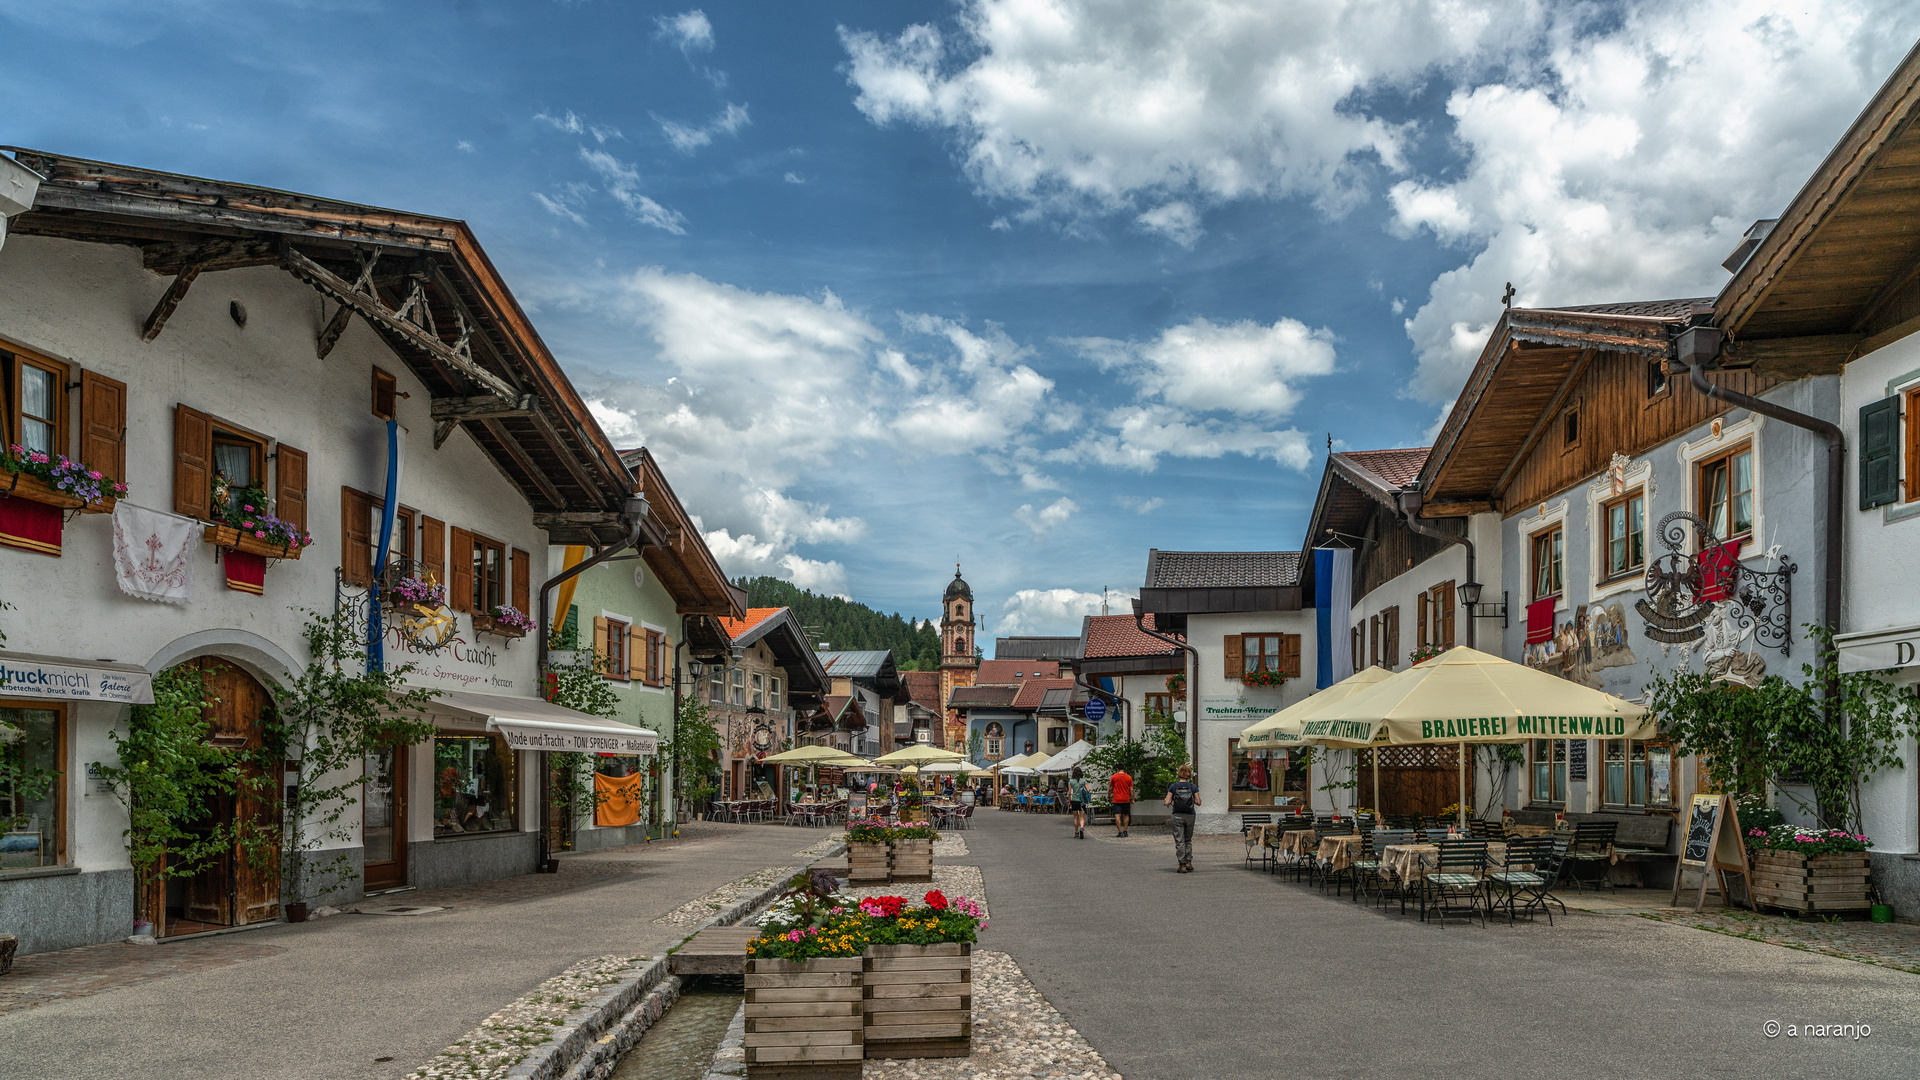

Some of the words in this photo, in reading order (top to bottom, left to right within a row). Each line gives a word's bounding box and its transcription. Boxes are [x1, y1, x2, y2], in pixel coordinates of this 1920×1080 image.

[449, 638, 497, 669] Tracht
[0, 665, 90, 689] druckmichl
[100, 680, 132, 692] Galerie
[433, 665, 482, 687] Sprenger
[1, 684, 42, 693] erbetechnik
[47, 687, 66, 695] Druck
[1248, 731, 1271, 742] Brauerei
[1274, 730, 1299, 741] Mittenwa
[1302, 720, 1331, 736] BRAUEREI
[1329, 719, 1372, 740] MITTENWALD
[1421, 716, 1507, 739] BRAUEREI
[1517, 715, 1625, 736] MITTENWALD
[507, 732, 528, 746] Mode
[529, 732, 542, 746] und
[544, 734, 565, 748] Tracht
[574, 736, 588, 749] TONI
[590, 736, 619, 750] SPRENGER
